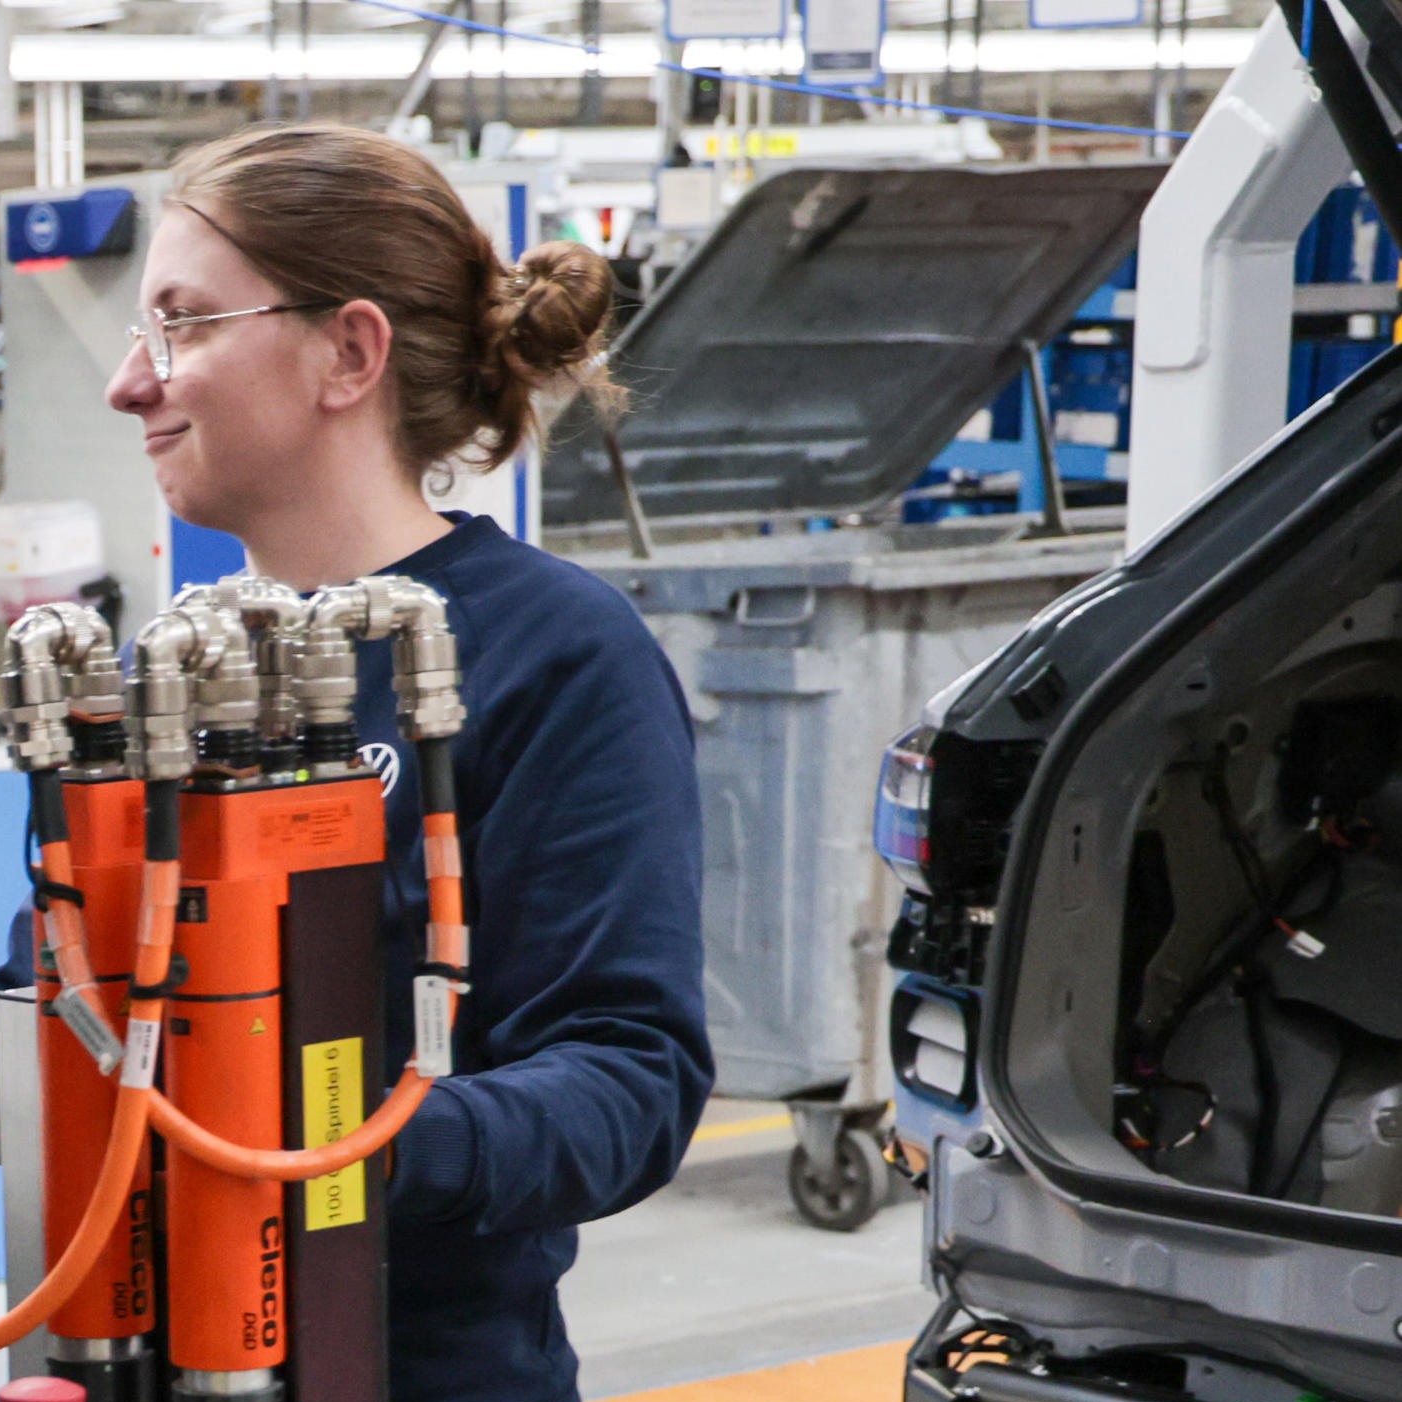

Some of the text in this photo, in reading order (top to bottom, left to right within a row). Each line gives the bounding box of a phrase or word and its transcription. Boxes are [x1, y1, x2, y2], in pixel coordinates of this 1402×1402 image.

[324, 1047, 339, 1060] 6
[325, 1067, 343, 1142] Spindel
[327, 1184, 342, 1220] 100
[130, 1189, 149, 1316] Cleco
[260, 1216, 281, 1347] Cleco
